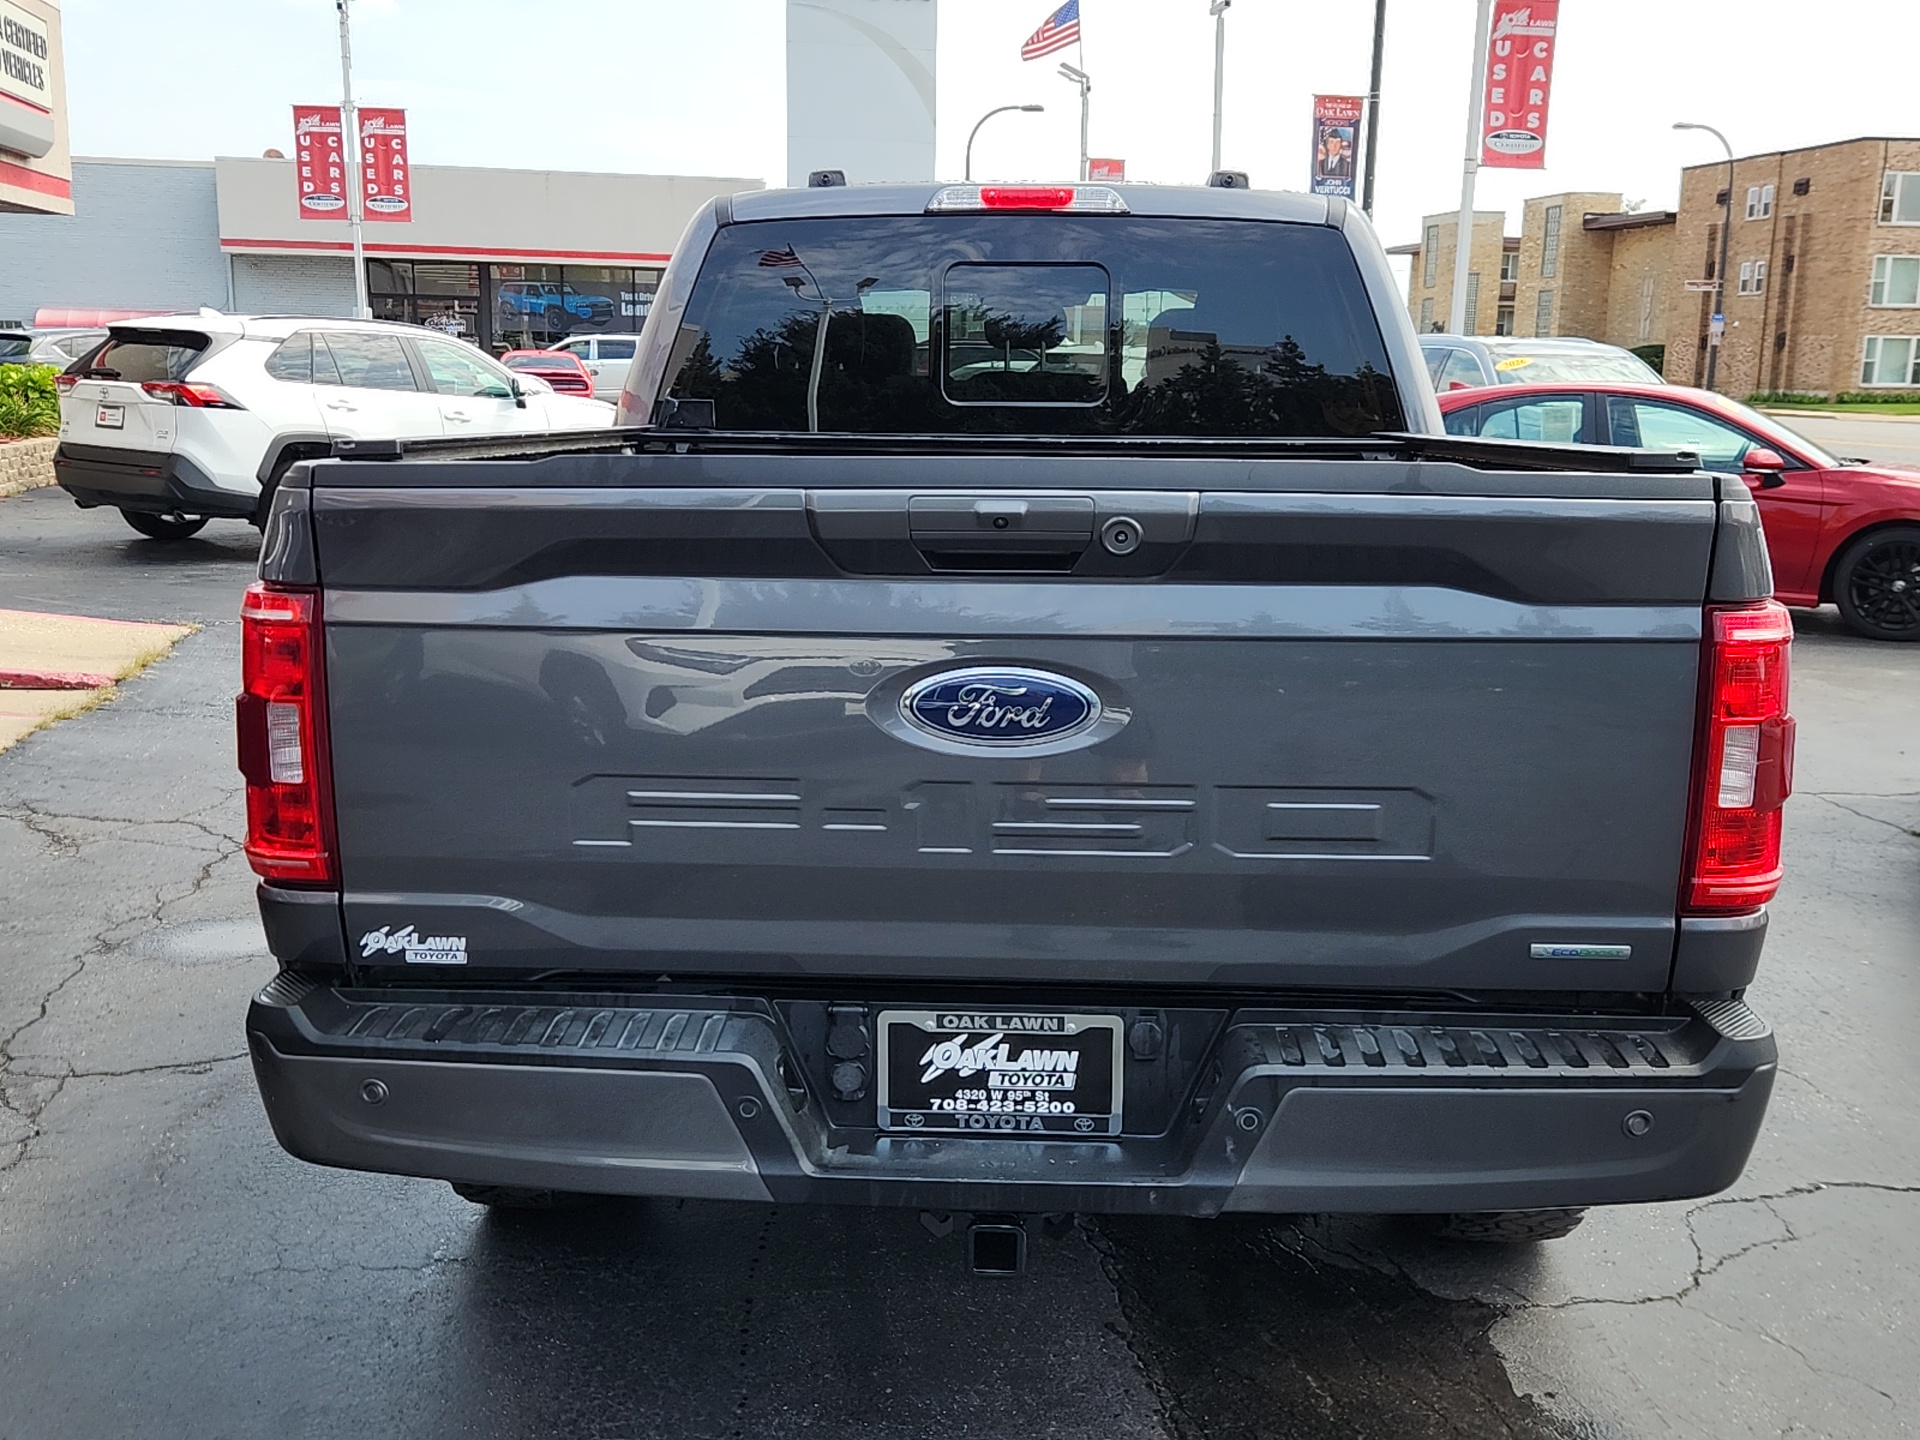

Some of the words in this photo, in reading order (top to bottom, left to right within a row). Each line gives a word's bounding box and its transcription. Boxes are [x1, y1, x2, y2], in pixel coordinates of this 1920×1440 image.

[1530, 19, 1555, 27] LAWN
[3, 15, 48, 60] CERTIFIED
[1, 47, 45, 91] VEHICLES
[1489, 40, 1511, 127] USED
[1526, 41, 1549, 128] CARS
[1316, 107, 1335, 116] OAK
[1336, 108, 1360, 117] LAWN
[299, 135, 315, 193] USED
[327, 136, 341, 193] CARS
[364, 137, 379, 194] USED
[391, 138, 404, 195] CARS
[1315, 186, 1351, 195] VERTUCCI
[639, 292, 656, 302] Driv
[1503, 359, 1526, 369] 2026
[948, 684, 1053, 728] Ford
[572, 775, 1435, 861] F-150
[413, 952, 458, 960] TOYOTA
[942, 1015, 990, 1030] OAK
[995, 1017, 1059, 1031] LAWN
[998, 1073, 1066, 1087] TOYOTA
[955, 1089, 987, 1100] 4320
[991, 1090, 1004, 1100] W
[1007, 1091, 1031, 1101] 95th
[1035, 1091, 1050, 1101] St
[929, 1098, 1075, 1114] 708-423-5200
[955, 1114, 1045, 1130] TOYOTA
